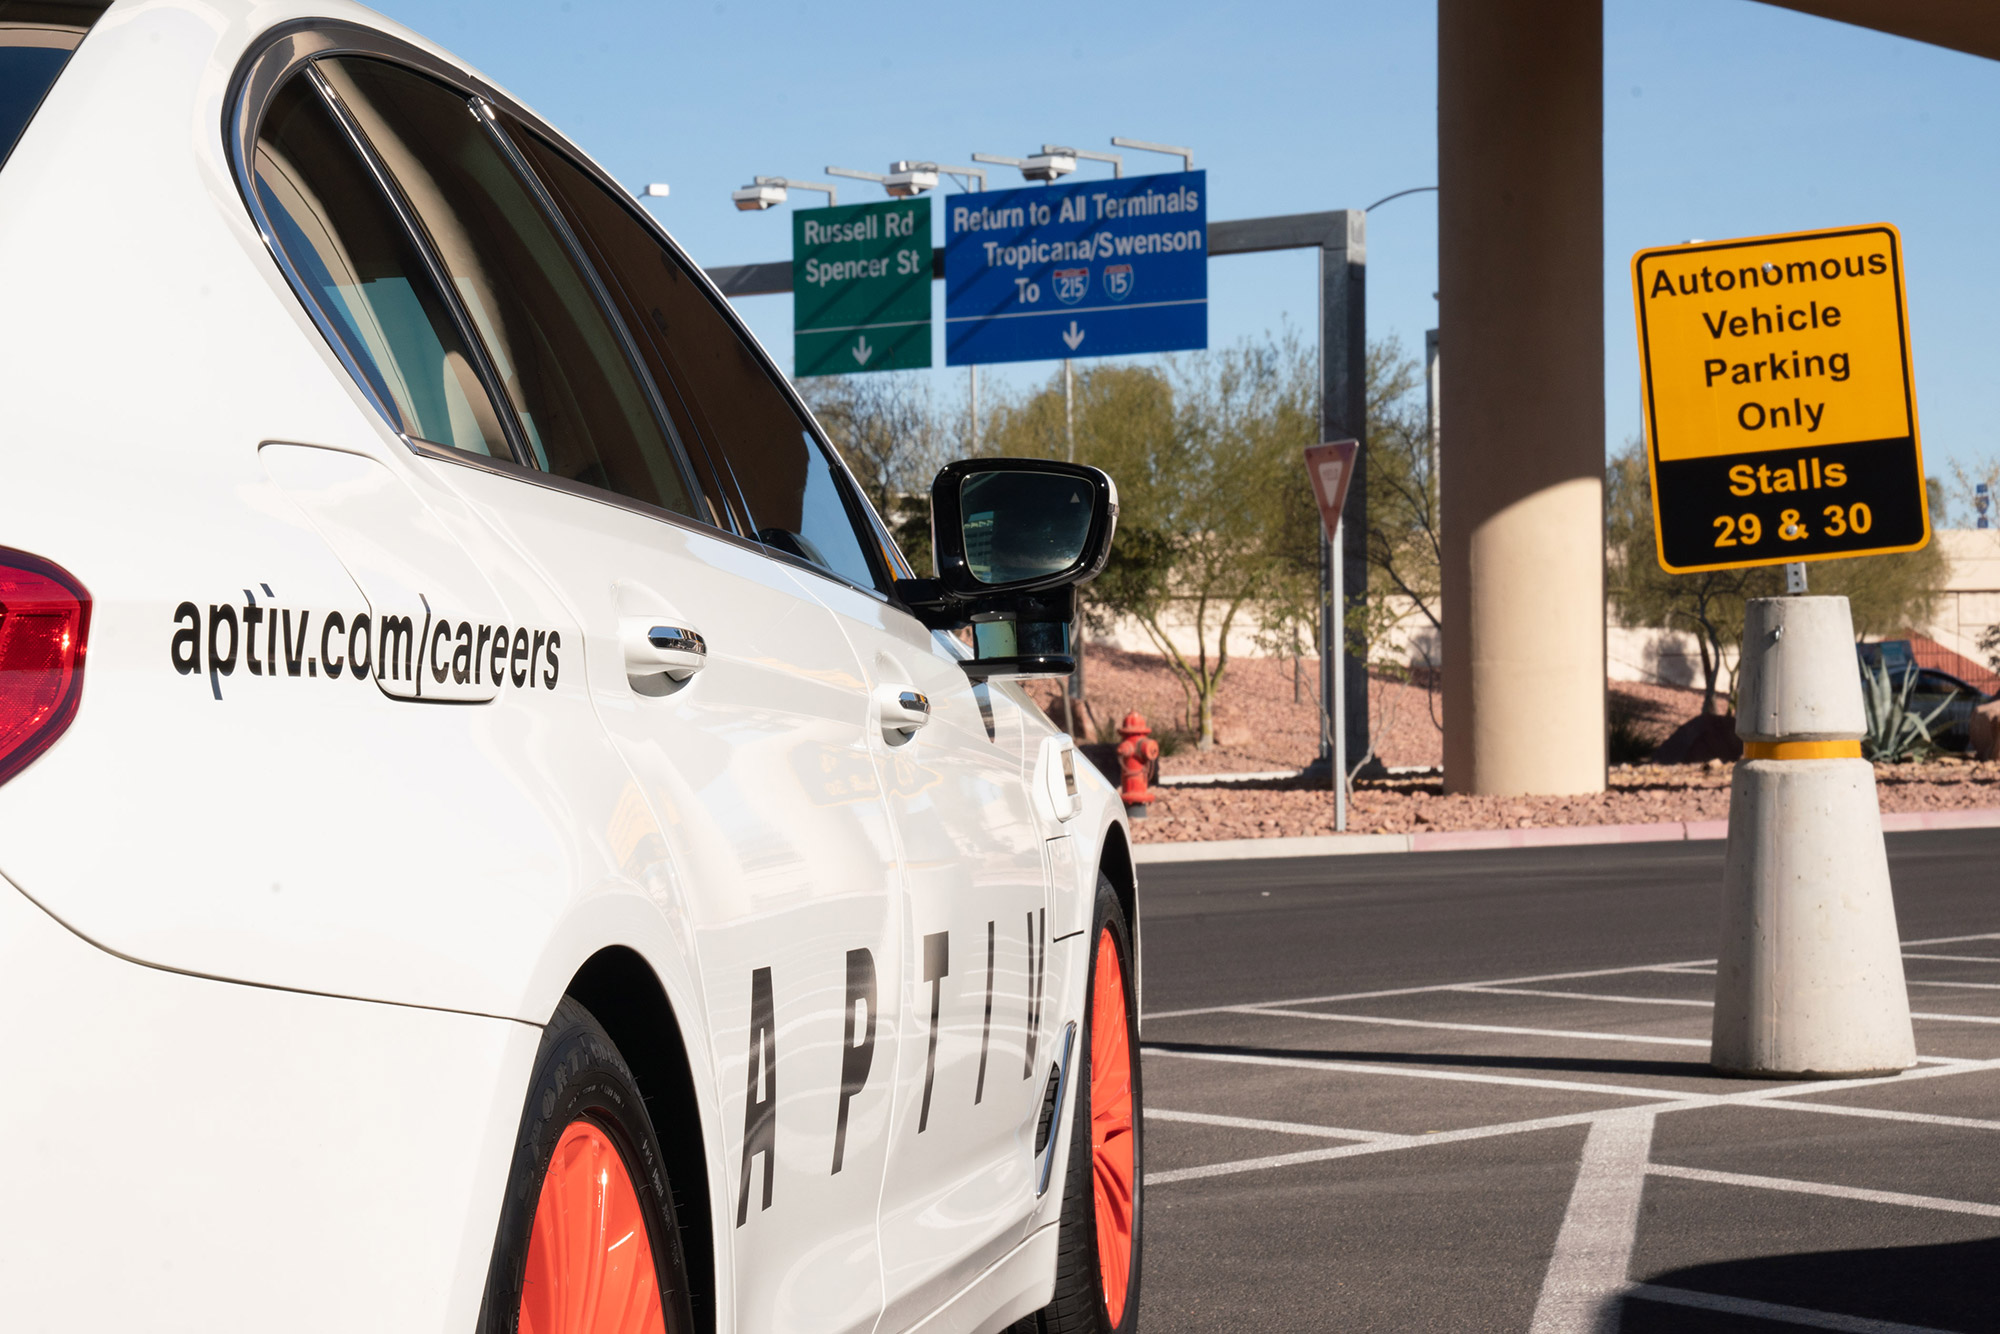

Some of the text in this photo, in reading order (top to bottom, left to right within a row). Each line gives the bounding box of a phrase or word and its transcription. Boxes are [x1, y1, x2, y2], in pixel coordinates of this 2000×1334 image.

[804, 210, 914, 246] Russell Rd
[953, 187, 1199, 233] Return to All Terminals
[805, 248, 920, 288] Spencer St
[983, 229, 1202, 271] Tropicana/Swenson
[1014, 277, 1040, 304] To
[1060, 276, 1084, 298] 215
[1110, 272, 1128, 294] 15
[1650, 252, 1888, 299] Autonomous
[1702, 301, 1842, 340] Vehicle
[1704, 350, 1851, 388] Parking
[1737, 397, 1826, 433] Only
[1728, 457, 1848, 497] Stalls
[1712, 502, 1873, 548] 29 & 30
[171, 582, 562, 701] aptiv.com/careers
[735, 906, 1046, 1230] APTIV
